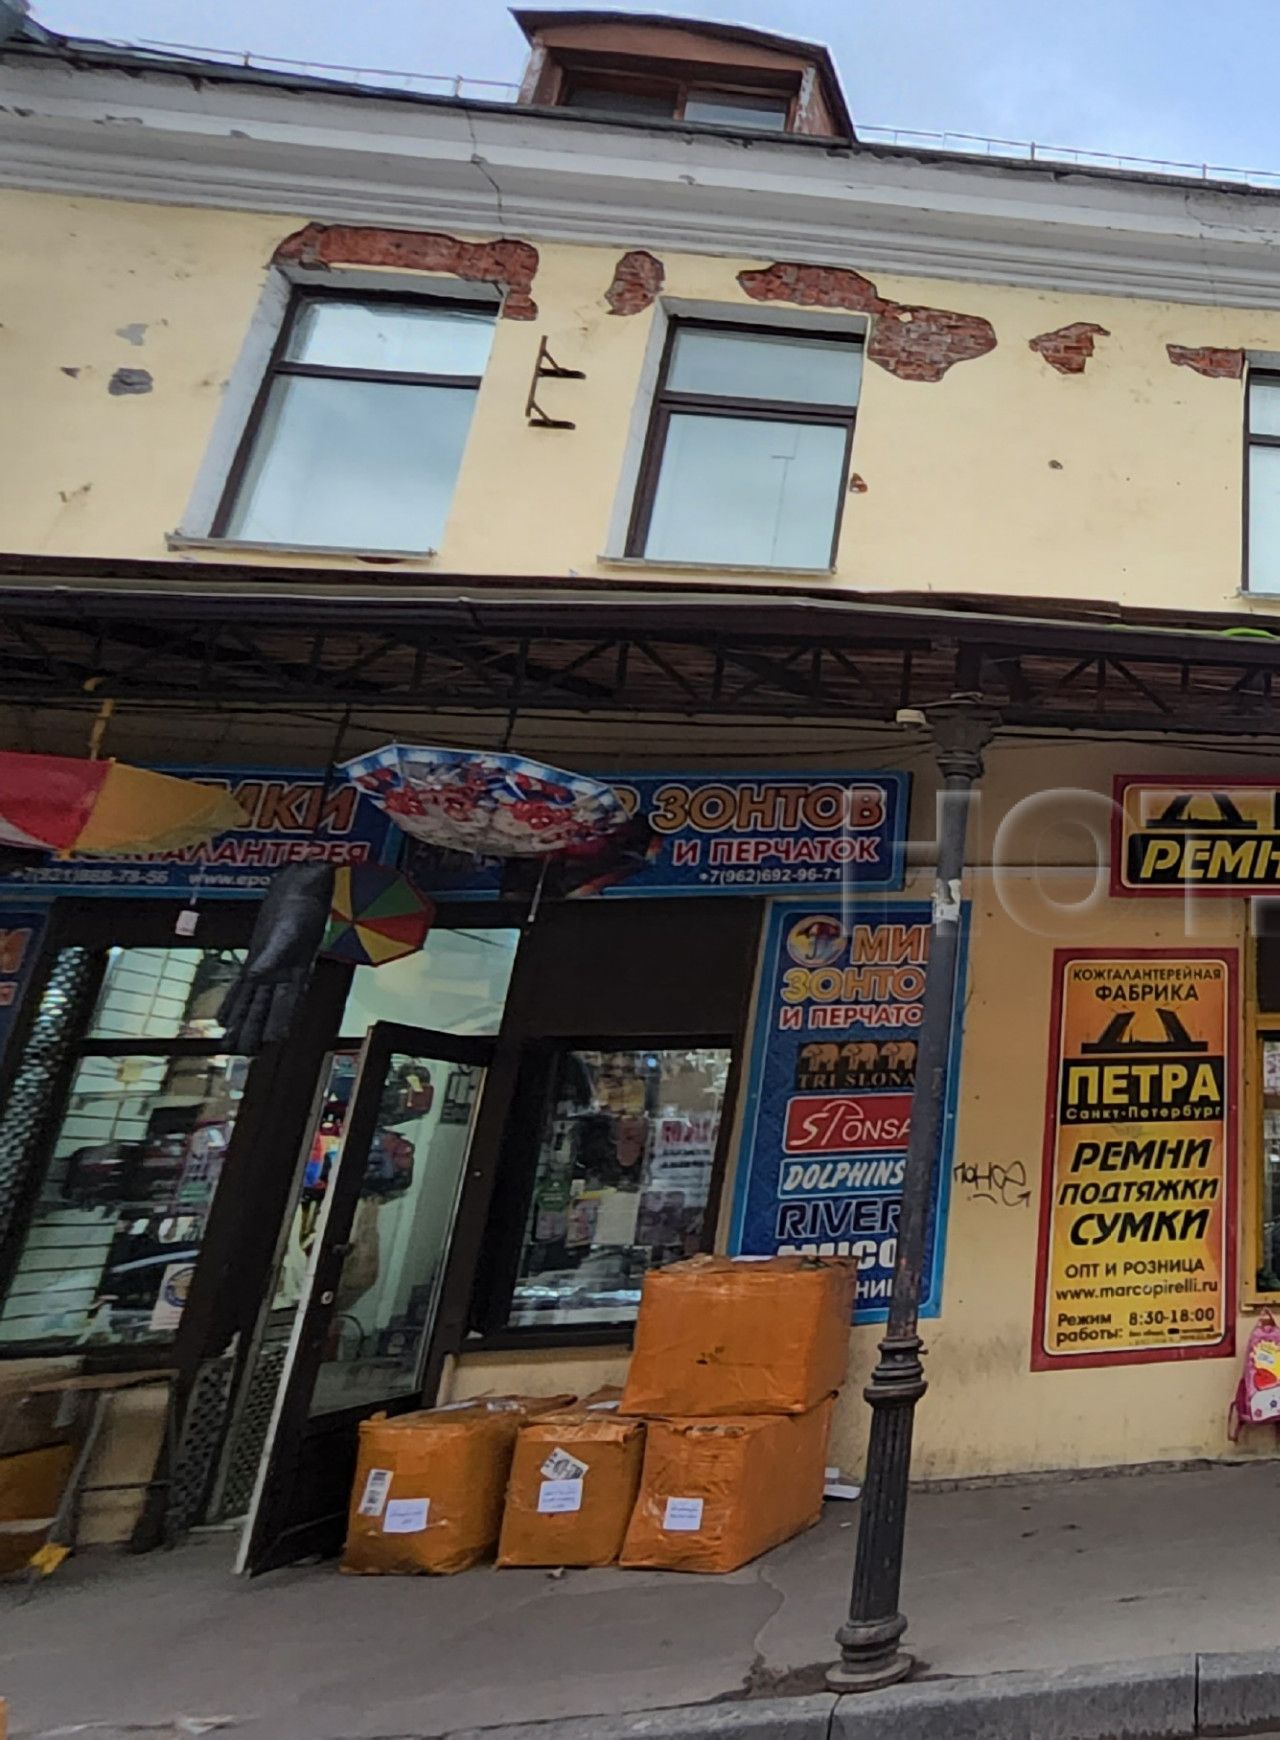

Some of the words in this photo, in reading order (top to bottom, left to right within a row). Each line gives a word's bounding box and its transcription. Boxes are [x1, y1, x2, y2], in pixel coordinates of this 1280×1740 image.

[648, 783, 888, 834] ЗОНТОВ
[670, 839, 700, 866] И
[708, 836, 880, 865] ПЕРЧАТОК
[699, 867, 842, 885] +7(962)692-96-71
[849, 924, 931, 964] МИ
[780, 967, 927, 1002] ЗОНТО
[1073, 966, 1221, 981] КОЖГАЛАНТЕРЕЙНАЯ
[1095, 984, 1199, 1001] ФАБРИКА
[779, 1006, 803, 1030] И
[808, 1004, 924, 1028] ПЕРЧАТО
[798, 1073, 837, 1089] TRI
[1067, 1064, 1221, 1105] ПЕТРА
[1065, 1105, 1221, 1120] Санкт-Петербург
[1070, 1138, 1212, 1173] РЕМНИ
[783, 1158, 906, 1192] DOLPHINS
[1058, 1178, 1219, 1205] ПОДТЯЖКИ
[1070, 1208, 1210, 1245] СУМКИ
[1065, 1263, 1099, 1278] ОПТ
[1105, 1262, 1116, 1275] И
[1123, 1258, 1206, 1275] РОЗНИЦА
[1056, 1279, 1218, 1300] www.marcopirelli.ru
[1057, 1312, 1112, 1327] Режим
[1056, 1326, 1123, 1347] работы:
